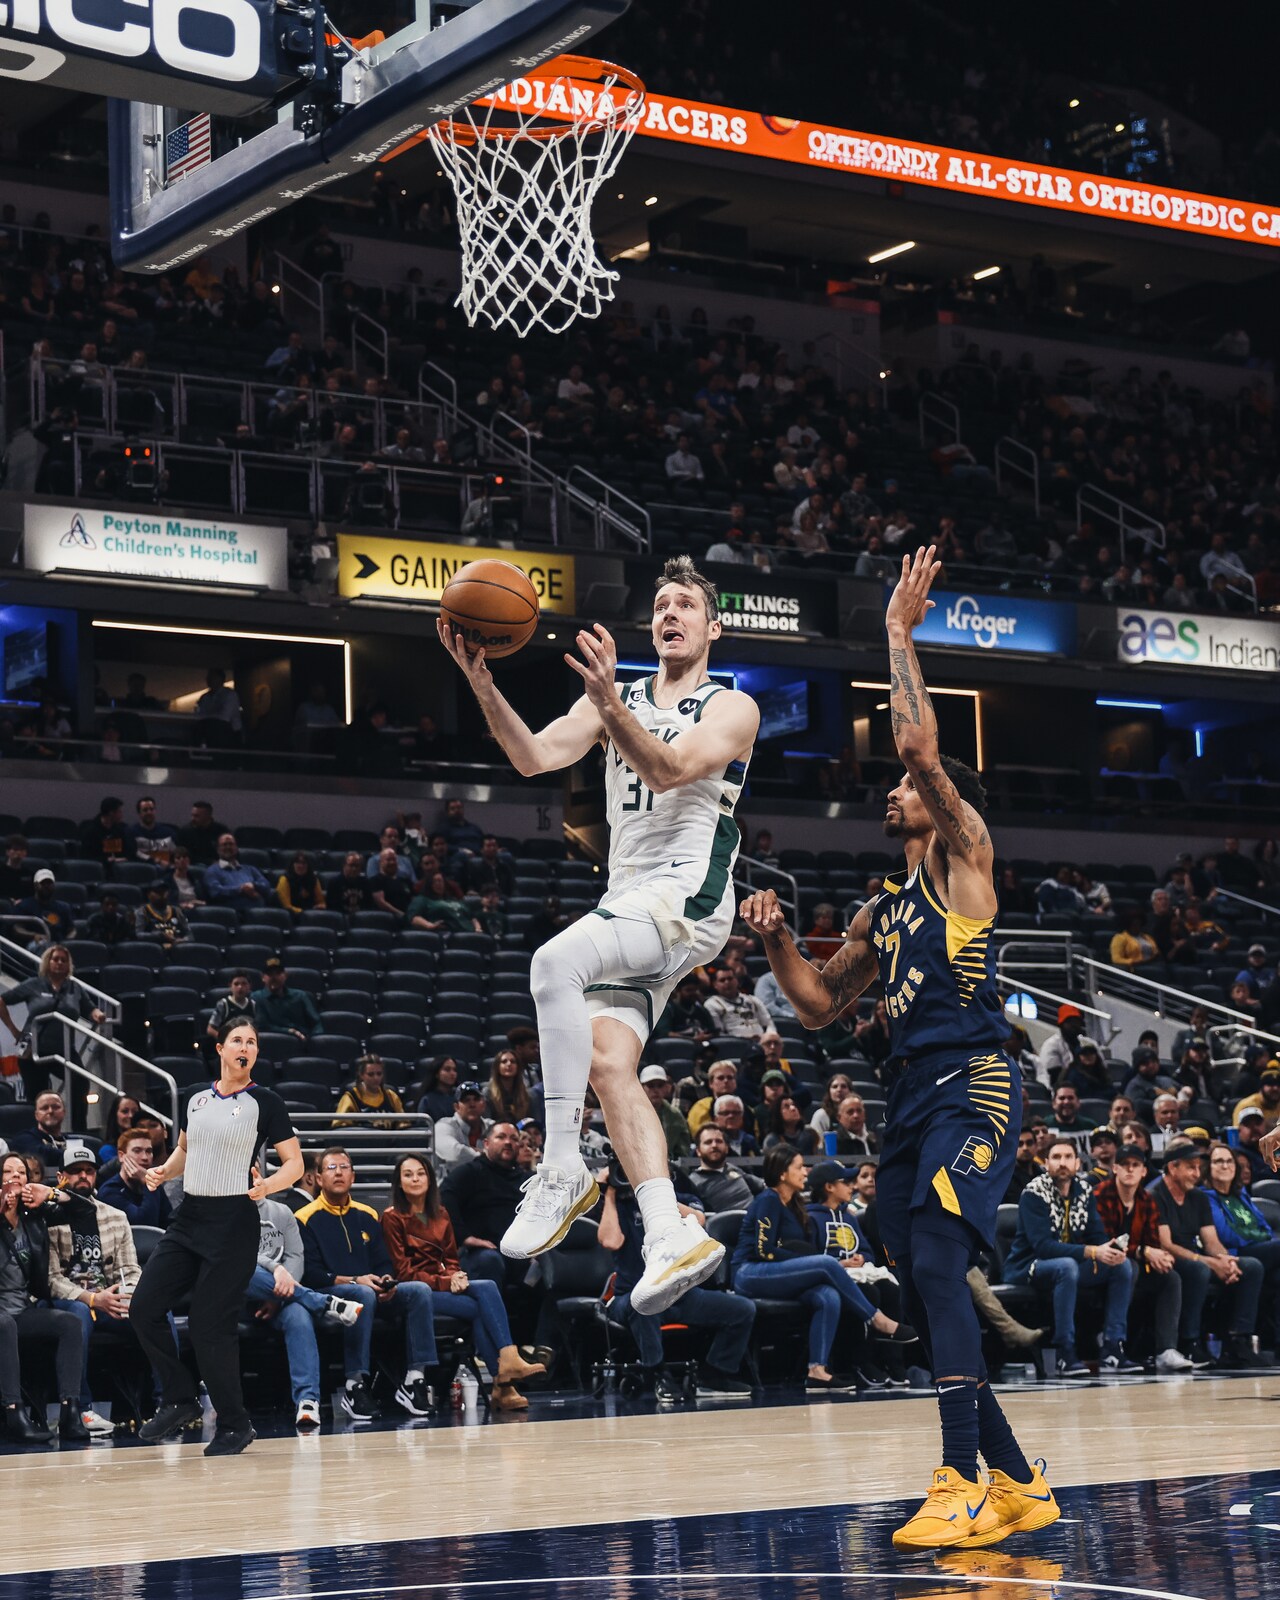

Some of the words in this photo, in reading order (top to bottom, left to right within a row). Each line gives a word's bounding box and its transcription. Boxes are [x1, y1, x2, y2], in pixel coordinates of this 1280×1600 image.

[0, 0, 260, 81] CO
[522, 24, 592, 68] DRAFTKINGS
[442, 77, 505, 115] DRAFTKINGS
[484, 77, 616, 120] NDIANA
[626, 97, 748, 145] PACERS
[364, 123, 424, 163] DRAFTKINGS
[291, 171, 349, 199] DRAFTKINGS
[808, 130, 941, 173] ORTHOINDY
[945, 156, 1074, 203] ALL-STAR
[1079, 180, 1247, 233] ORTHOPEDIC
[220, 206, 277, 238] DRAFTKINGS
[103, 514, 161, 536] Peyton
[166, 520, 238, 544] Manning
[103, 537, 185, 558] Children's
[190, 542, 258, 565] Hospital
[390, 554, 563, 600] GAINGE
[717, 611, 800, 632] ORTSBOOK
[718, 592, 801, 615] FTKINGS
[946, 596, 1017, 649] Kroger
[1121, 614, 1200, 661] aes
[1208, 634, 1280, 672] Indian
[536, 806, 551, 831] 16
[873, 899, 925, 949] NDIANA
[885, 929, 901, 985] 7
[885, 966, 925, 1018] CERS
